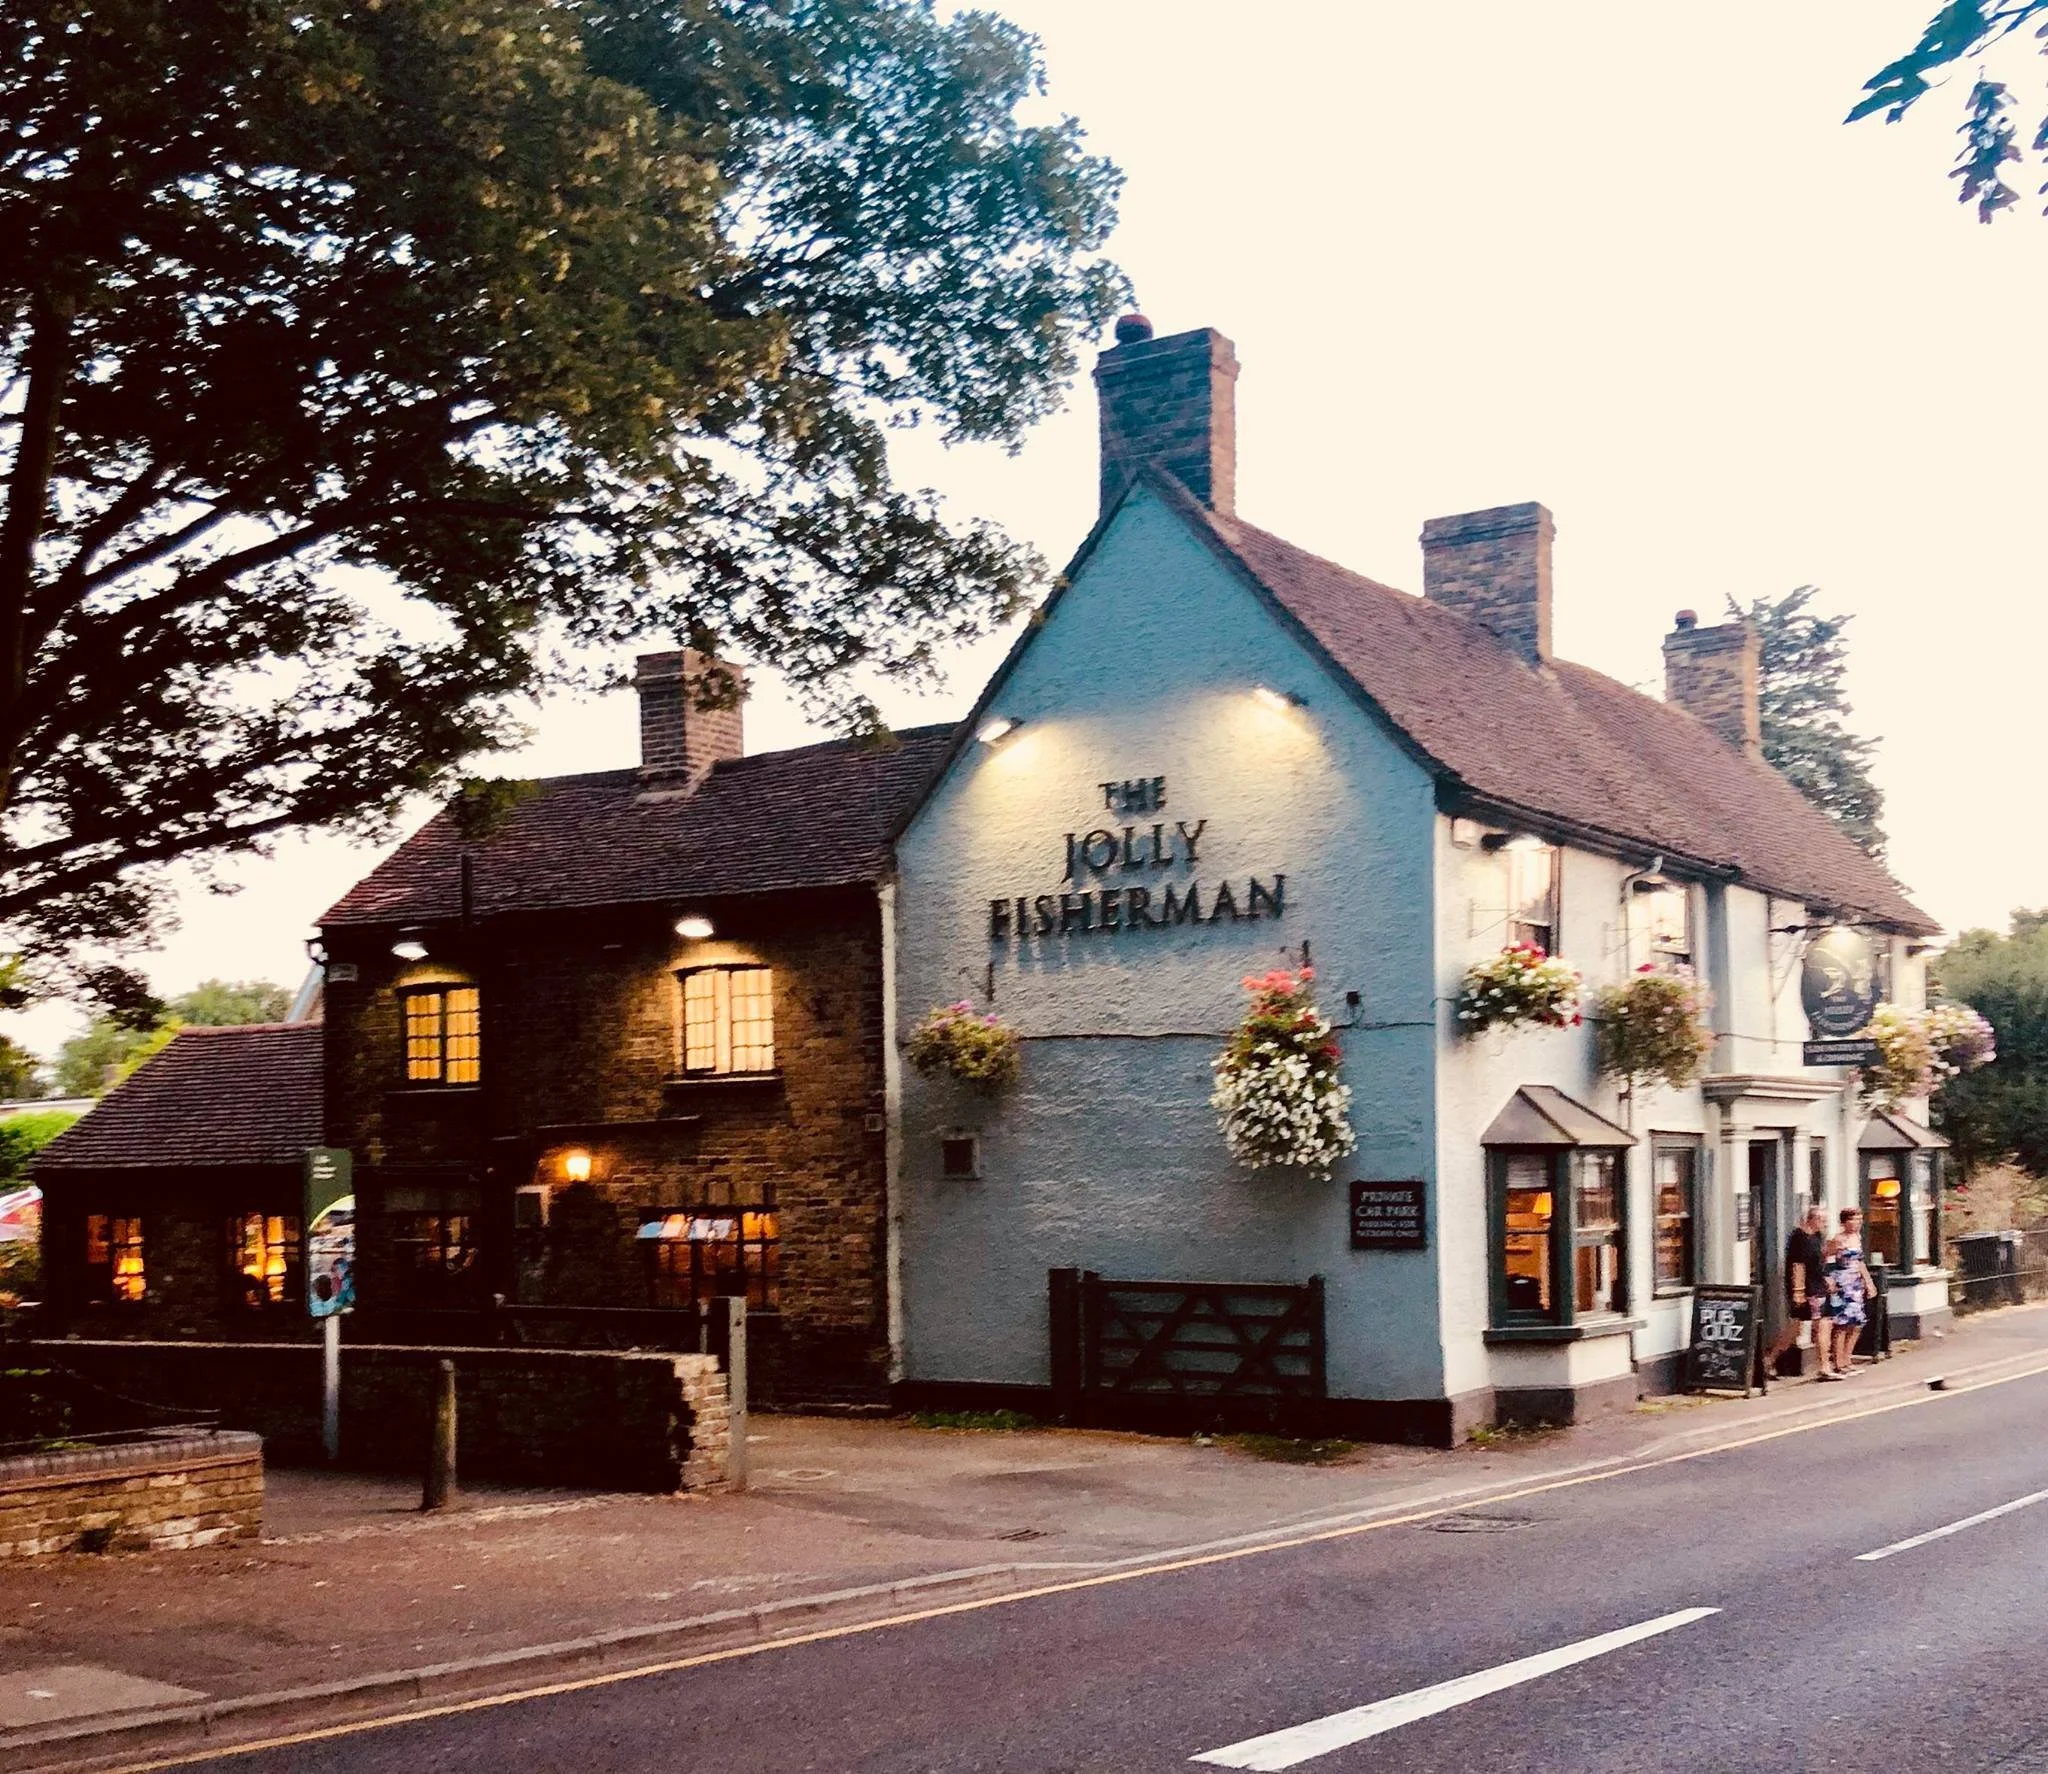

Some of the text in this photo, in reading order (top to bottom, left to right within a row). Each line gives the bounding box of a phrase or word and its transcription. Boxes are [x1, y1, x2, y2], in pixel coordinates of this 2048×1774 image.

[1098, 775, 1167, 810] THE
[1061, 819, 1207, 884] JOLLY
[988, 874, 1287, 938] FISHERMAN
[1355, 1205, 1419, 1217] CAR PARK
[1699, 1309, 1735, 1326] PUB
